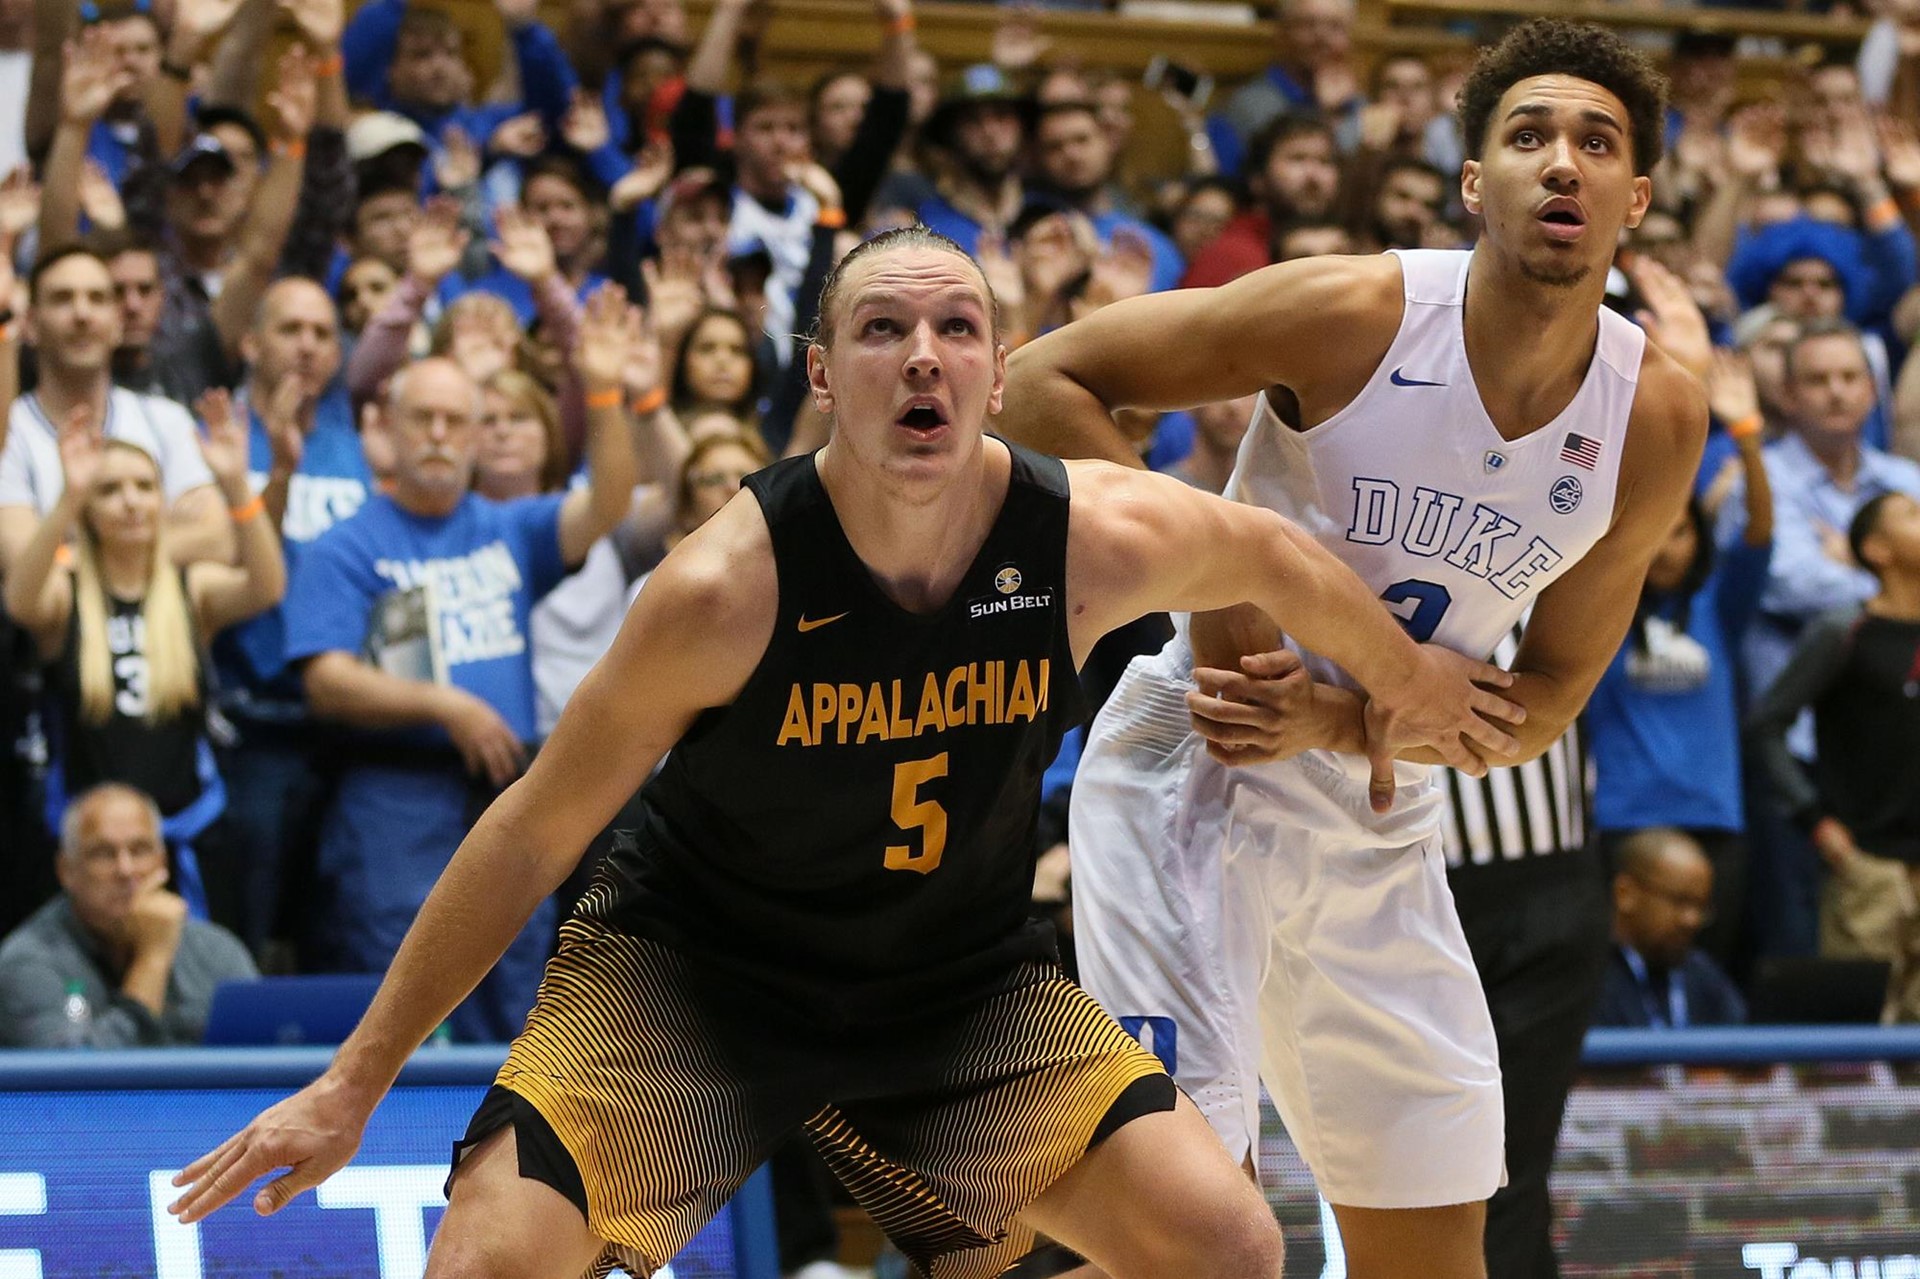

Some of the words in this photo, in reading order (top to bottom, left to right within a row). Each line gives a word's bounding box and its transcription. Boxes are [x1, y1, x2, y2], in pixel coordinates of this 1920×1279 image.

[1346, 476, 1563, 600] DUKE
[970, 600, 1008, 618] SUN
[1010, 595, 1051, 610] BELT
[883, 751, 948, 875] 5
